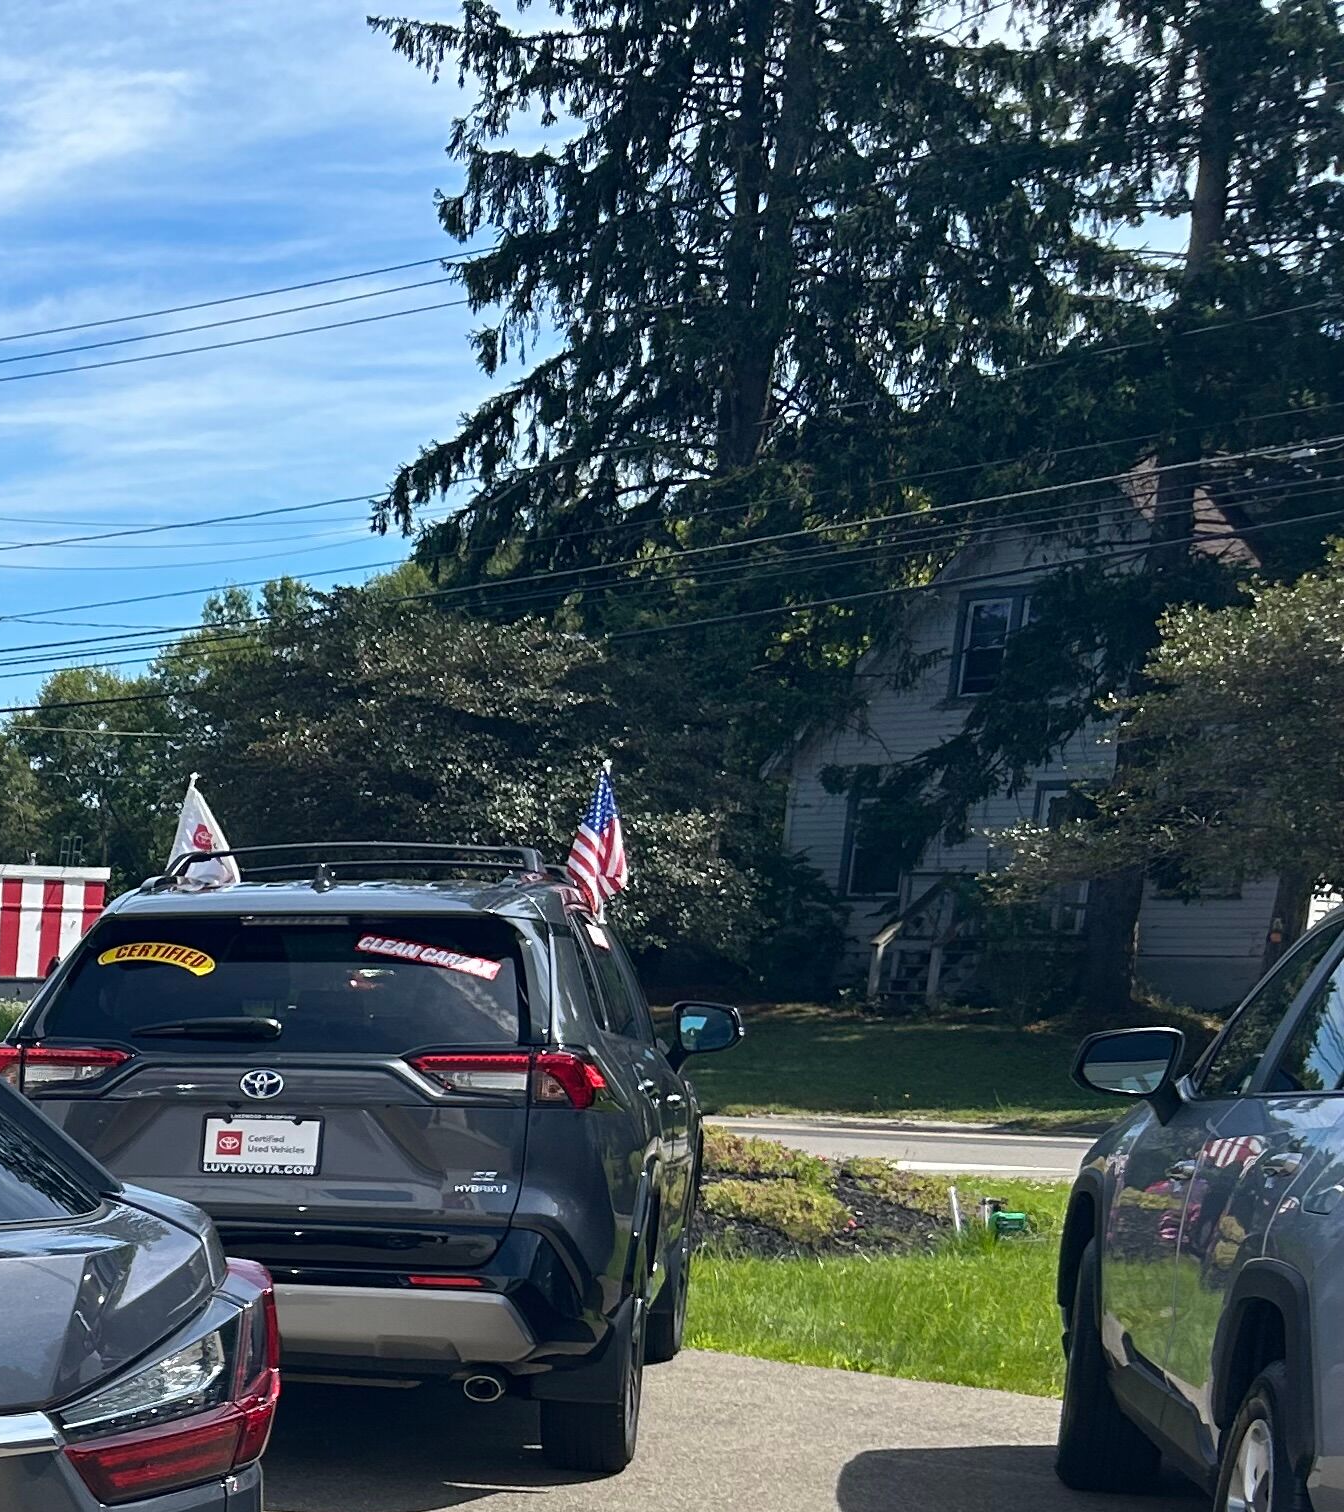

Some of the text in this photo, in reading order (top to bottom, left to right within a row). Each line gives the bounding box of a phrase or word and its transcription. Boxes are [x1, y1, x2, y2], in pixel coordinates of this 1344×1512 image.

[357, 936, 421, 958] CLEAN
[115, 944, 208, 968] CERTIFIED
[248, 1135, 285, 1143] Certified
[248, 1145, 305, 1154] Used Vehicles
[203, 1163, 315, 1175] LUVTOYOTA.COM
